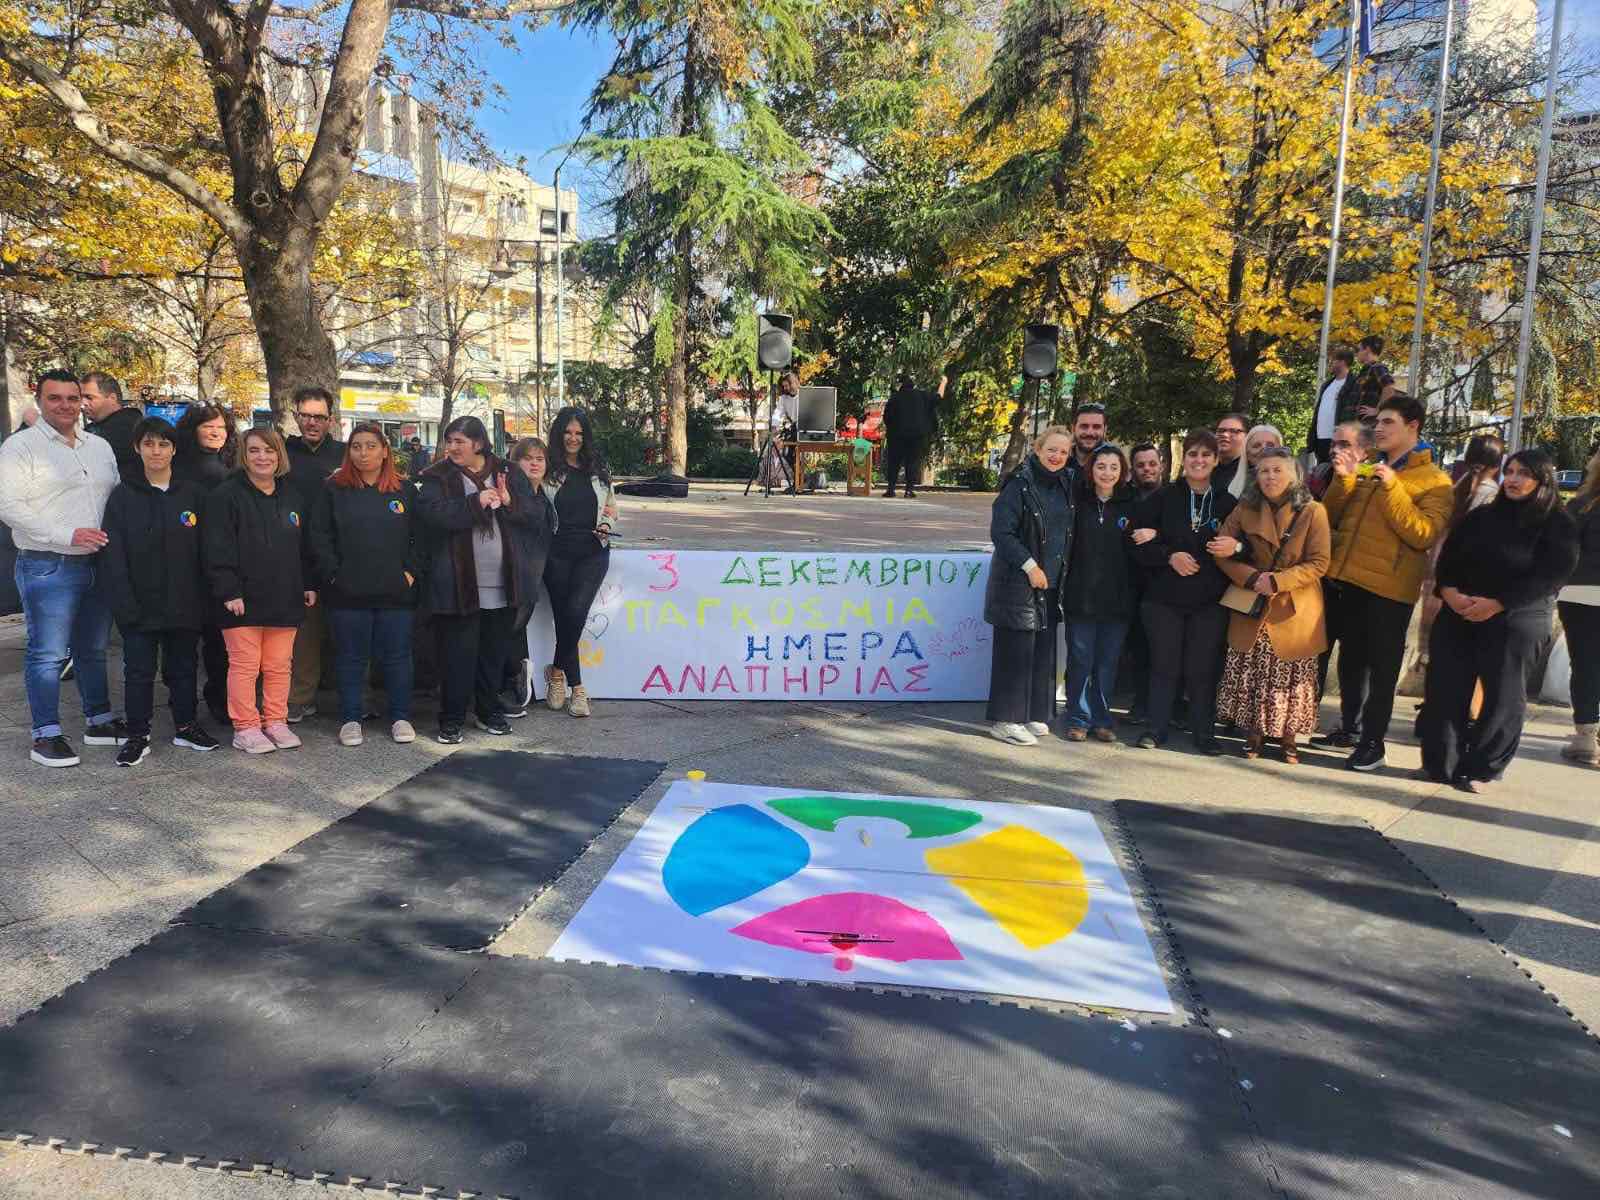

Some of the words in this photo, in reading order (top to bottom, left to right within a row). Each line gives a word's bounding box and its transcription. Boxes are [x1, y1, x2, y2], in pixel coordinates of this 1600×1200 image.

[648, 553, 679, 592] 3
[720, 556, 983, 588] ΔΕΚΕΜΒΡΙΟΥ
[624, 597, 936, 632] ΠΑΓΚΟΣΜΙΑ
[744, 631, 924, 662] ΗΜΕΡΑ
[640, 663, 932, 696] ΑΝΑΠΗΡΙΑΣ
